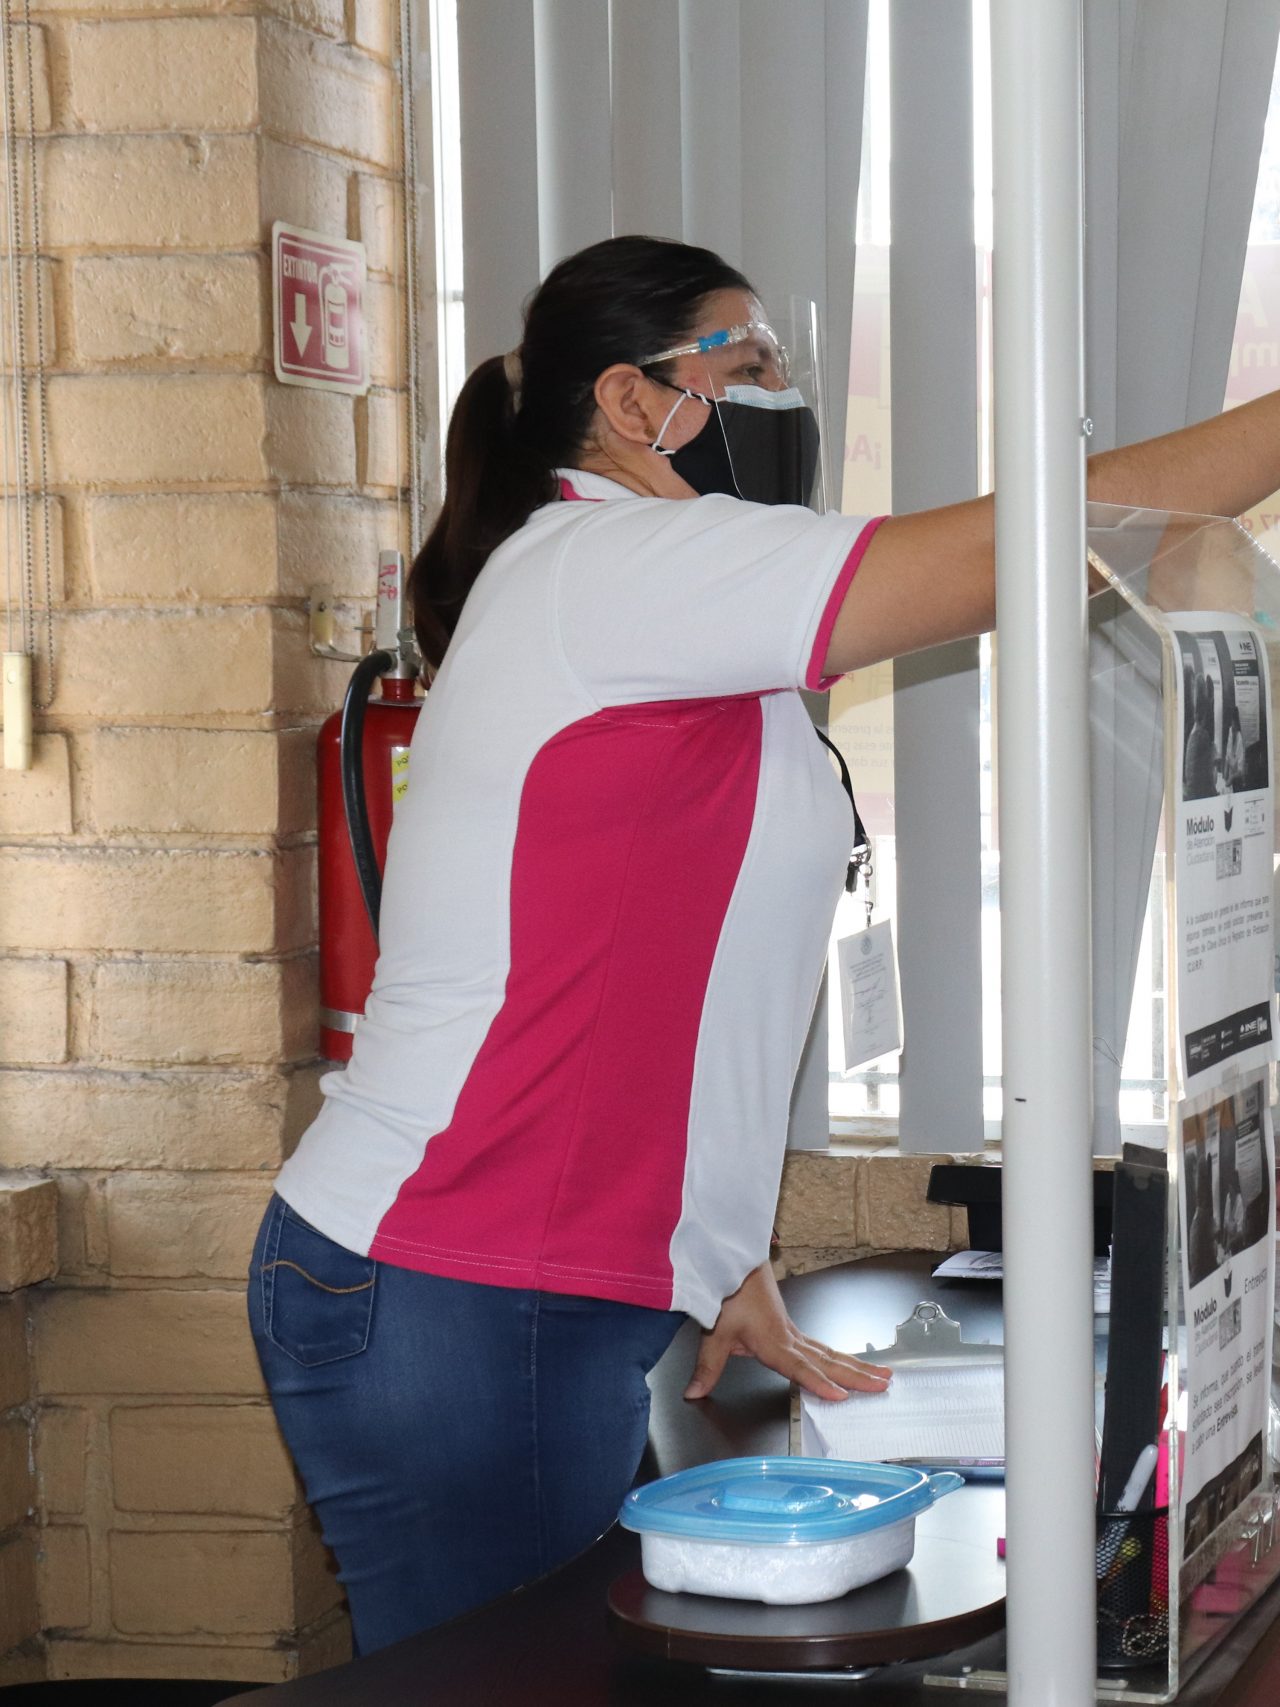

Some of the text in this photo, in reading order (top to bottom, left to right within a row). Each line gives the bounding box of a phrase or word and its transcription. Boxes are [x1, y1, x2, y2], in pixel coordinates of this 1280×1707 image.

[283, 254, 317, 283] EXTINTOR
[1187, 815, 1214, 836] Módulo
[1194, 1297, 1217, 1328] Módulo
